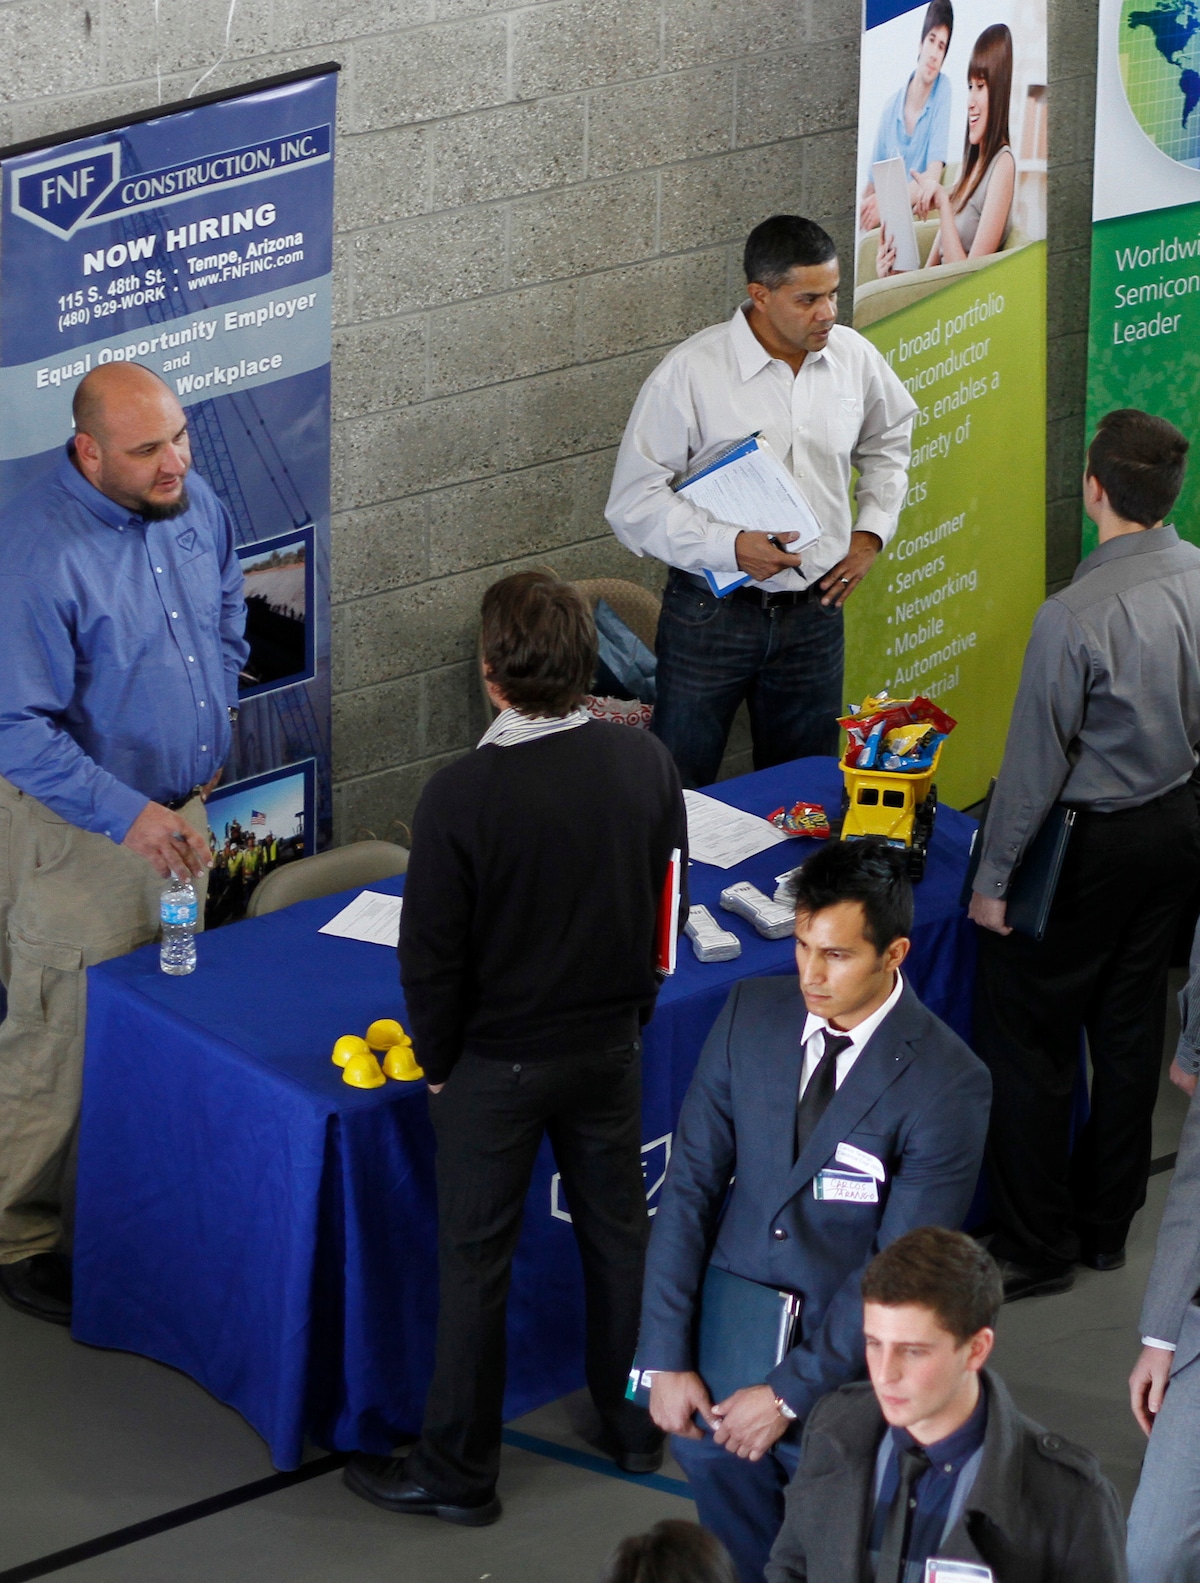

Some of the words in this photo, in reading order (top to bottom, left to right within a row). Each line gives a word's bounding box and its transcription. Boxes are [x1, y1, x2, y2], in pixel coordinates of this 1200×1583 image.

[41, 166, 95, 209] FNF
[121, 148, 276, 205] CONSTRUCTION,
[280, 136, 317, 162] INC.
[83, 235, 156, 276] NOW
[166, 203, 277, 252] HIRING
[58, 291, 83, 311] 115
[88, 286, 103, 304] S.
[107, 275, 140, 297] 48th
[144, 269, 166, 288] St.
[187, 250, 242, 275] Tempe,
[246, 232, 304, 260] Arizona
[58, 310, 90, 332] (480)
[93, 286, 166, 319] 929-WORK
[187, 250, 304, 291] www.FNFINC.com
[36, 354, 91, 389] Equal
[224, 291, 317, 331] Employer
[899, 318, 941, 363] broad
[945, 292, 1005, 346] portfolio
[1113, 312, 1182, 345] Leader
[162, 352, 190, 373] and
[176, 352, 283, 396] Workplace
[902, 338, 990, 394] miconductor
[933, 376, 988, 419] enables
[990, 371, 1000, 389] a
[911, 431, 952, 468] ariety
[955, 414, 971, 444] of
[896, 512, 966, 561] Consumer
[895, 569, 978, 625] Networking
[896, 555, 945, 594] Servers
[893, 632, 977, 689] Automotive
[894, 616, 944, 656] Mobile
